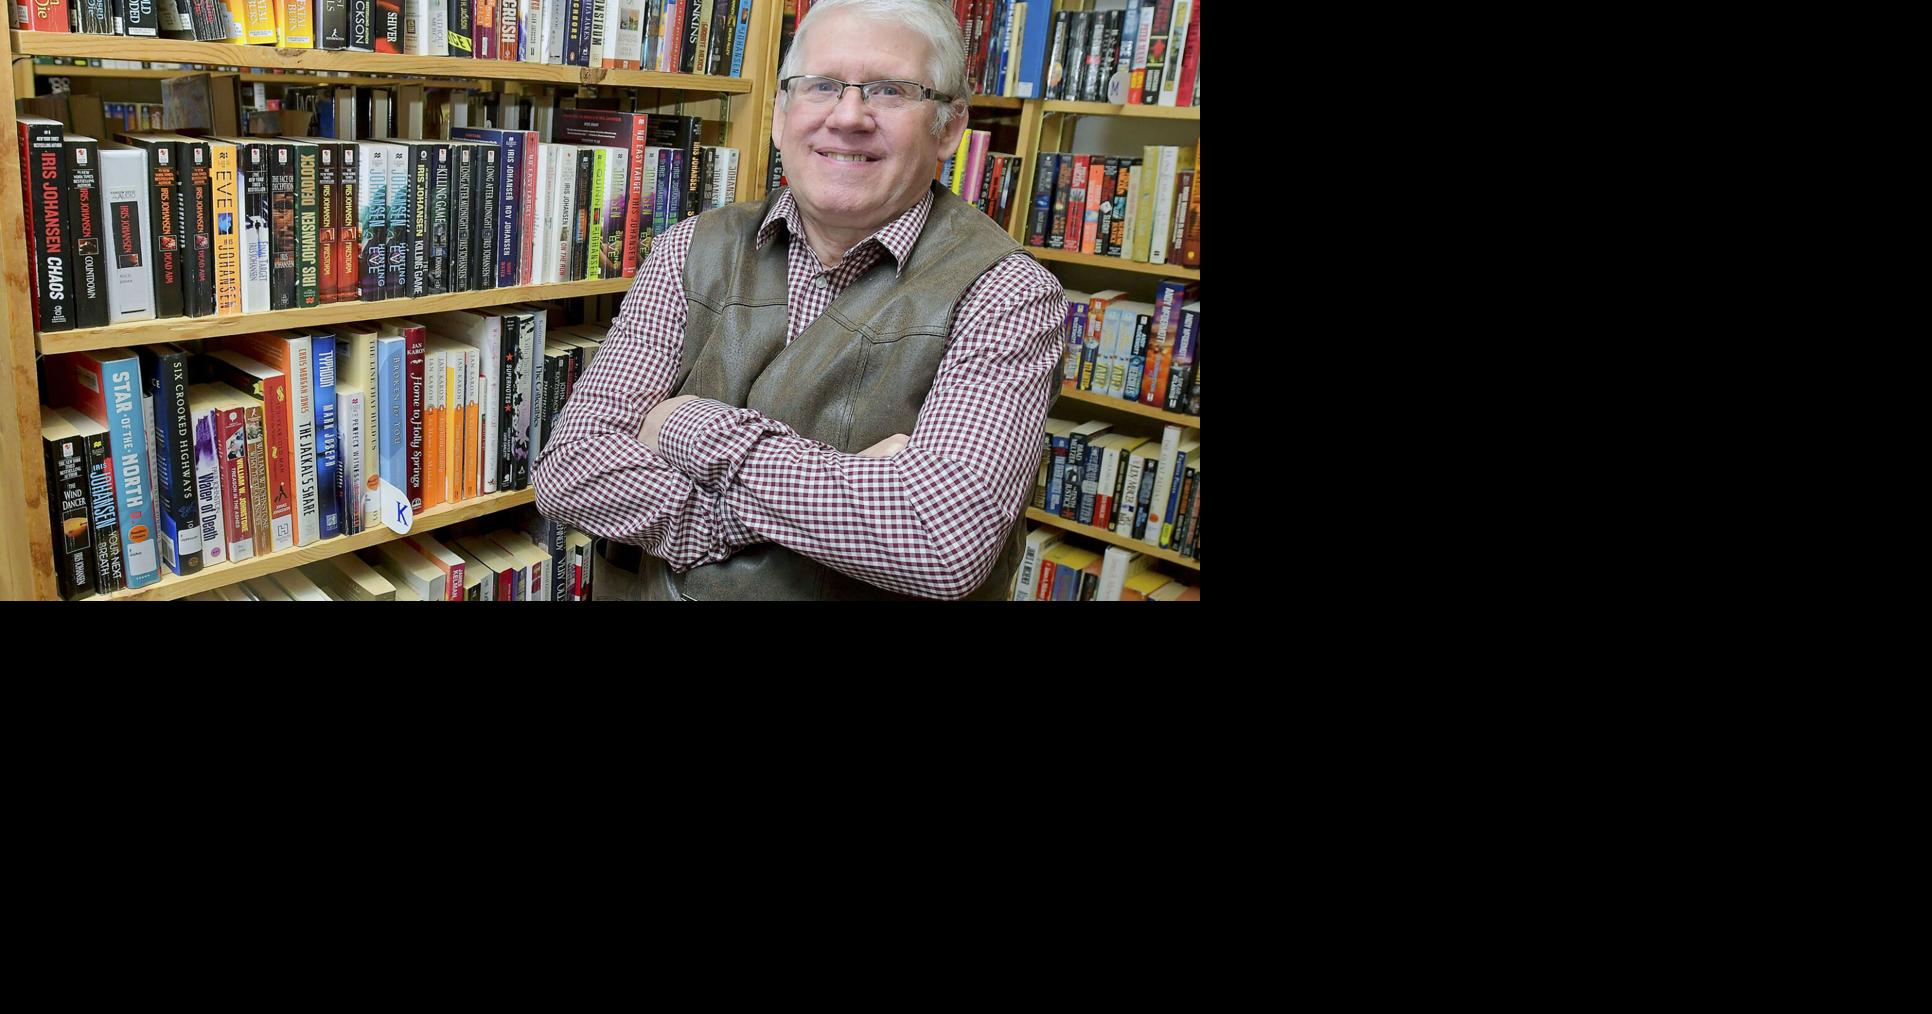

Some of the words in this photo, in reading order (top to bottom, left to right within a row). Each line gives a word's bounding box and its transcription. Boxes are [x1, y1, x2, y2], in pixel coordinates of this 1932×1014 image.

[355, 0, 365, 44] CKSON
[387, 12, 398, 42] SHIVER
[501, 0, 516, 43] CRUSH
[732, 28, 746, 75] JOHANSEN
[636, 129, 645, 141] NO
[692, 141, 700, 156] IRIS
[41, 152, 57, 179] IRIS
[507, 149, 515, 163] IRIS
[635, 144, 645, 163] EASY
[272, 183, 294, 191] DECEPTION
[301, 154, 316, 206] DEADLOCK
[417, 164, 425, 183] IRIS
[436, 168, 448, 200] KILLING
[461, 165, 470, 183] LONG
[486, 166, 495, 183] LONG
[505, 165, 514, 201] JOHANSEN
[633, 166, 643, 195] TARGET
[672, 166, 680, 179] IRIS
[689, 156, 699, 191] JOHANSEN
[80, 188, 89, 202] IRIS
[161, 188, 169, 200] IRIS
[216, 171, 232, 208] EVE
[323, 185, 331, 196] IRIS
[345, 185, 353, 196] IRIS
[369, 169, 386, 227] JOHANSEN
[390, 169, 407, 227] JOHANSEN
[563, 183, 571, 195] IRIS
[594, 168, 604, 208] QUINN
[657, 180, 665, 210] JOHANSEN
[670, 180, 680, 212] JOHANSEN
[42, 182, 61, 253] JOHANSEN
[80, 203, 92, 238] JOHANSEN
[120, 205, 129, 219] IRIS
[161, 202, 171, 234] JOHANSEN
[196, 200, 204, 233] JOHANSEN
[323, 197, 331, 228] JOHANSEN
[345, 197, 353, 226] JOHANSEN
[416, 185, 425, 237] JOHANSEN
[435, 200, 447, 224] GAME
[459, 200, 469, 231] MIDNIGHT
[484, 200, 493, 229] MIDNIGHT
[505, 205, 513, 219] ROY
[562, 196, 570, 225] JOHANSEN
[1102, 214, 1111, 234] SLEIGHT
[121, 220, 133, 253] JOHANSEN
[249, 243, 257, 255] IRIS
[259, 241, 268, 259] FINAL
[301, 211, 316, 265] JOHANSEN
[503, 221, 511, 256] JOHANSEN
[607, 235, 617, 258] EVE
[628, 219, 638, 261] JOHANSEN
[164, 253, 173, 272] DEAD
[274, 261, 295, 269] JOHANSEN
[323, 243, 331, 275] FIRESTORM
[345, 242, 353, 273] FIRESTORM
[369, 246, 380, 274] EVE
[378, 243, 386, 287] HUNTING
[389, 245, 401, 272] EVE
[414, 240, 424, 269] KILLING
[459, 250, 468, 279] JOHANSEN
[482, 250, 491, 277] JOHANSEN
[590, 231, 600, 277] JOHANSEN
[47, 256, 65, 300] CHAOS
[85, 256, 97, 299] COUNTDOWN
[218, 245, 237, 309] JOHANSEN
[249, 256, 258, 282] JOHANSEN
[258, 260, 269, 282] TARGET
[302, 267, 316, 287] IRIS
[414, 270, 423, 294] GAME
[1163, 287, 1175, 305] ANDY
[1184, 312, 1194, 327] ANDY
[407, 347, 426, 355] KARON
[174, 362, 183, 381] SIX
[300, 368, 308, 394] MORGAN
[319, 350, 334, 388] TYPHOON
[392, 356, 400, 400] BROKEN
[1127, 366, 1138, 394] HERCULES
[112, 371, 133, 414] STAR
[410, 372, 422, 407] Home
[505, 364, 513, 404] SUPERNOTES
[175, 384, 187, 437] CROOKED
[300, 395, 309, 414] JONES
[323, 404, 334, 430] MARK
[413, 409, 421, 420] to
[121, 418, 131, 431] OF
[299, 421, 311, 440] THE
[410, 418, 422, 449] Holly
[122, 432, 133, 449] THE
[324, 433, 335, 467] JOSEPH
[1068, 439, 1077, 464] MELTZER
[1075, 443, 1083, 461] BRAD
[93, 463, 107, 471] IRIS
[180, 440, 192, 500] HIGHWAYS
[256, 441, 265, 475] WILLIAM
[300, 441, 314, 485] JACKAL'S
[410, 451, 421, 488] Springs
[121, 453, 143, 508] NORTH
[198, 472, 213, 502] Water
[237, 459, 245, 487] WILLIAM
[63, 497, 86, 511] DANCER
[64, 489, 83, 500] WIND
[90, 471, 117, 529] JOHANSEN
[239, 488, 245, 496] W.
[302, 486, 315, 516] SHARE
[1063, 483, 1072, 508] JUSTICE
[200, 503, 213, 514] of
[240, 498, 248, 532] JOHNSTONE
[260, 487, 269, 529] JOHNSTONE
[396, 501, 409, 527] K
[108, 530, 120, 556] YOUR
[201, 515, 218, 542] Death
[98, 542, 110, 576] BREATH
[111, 557, 122, 579] NEXT
[556, 561, 565, 580] VERY
[452, 569, 460, 598] KELMAN
